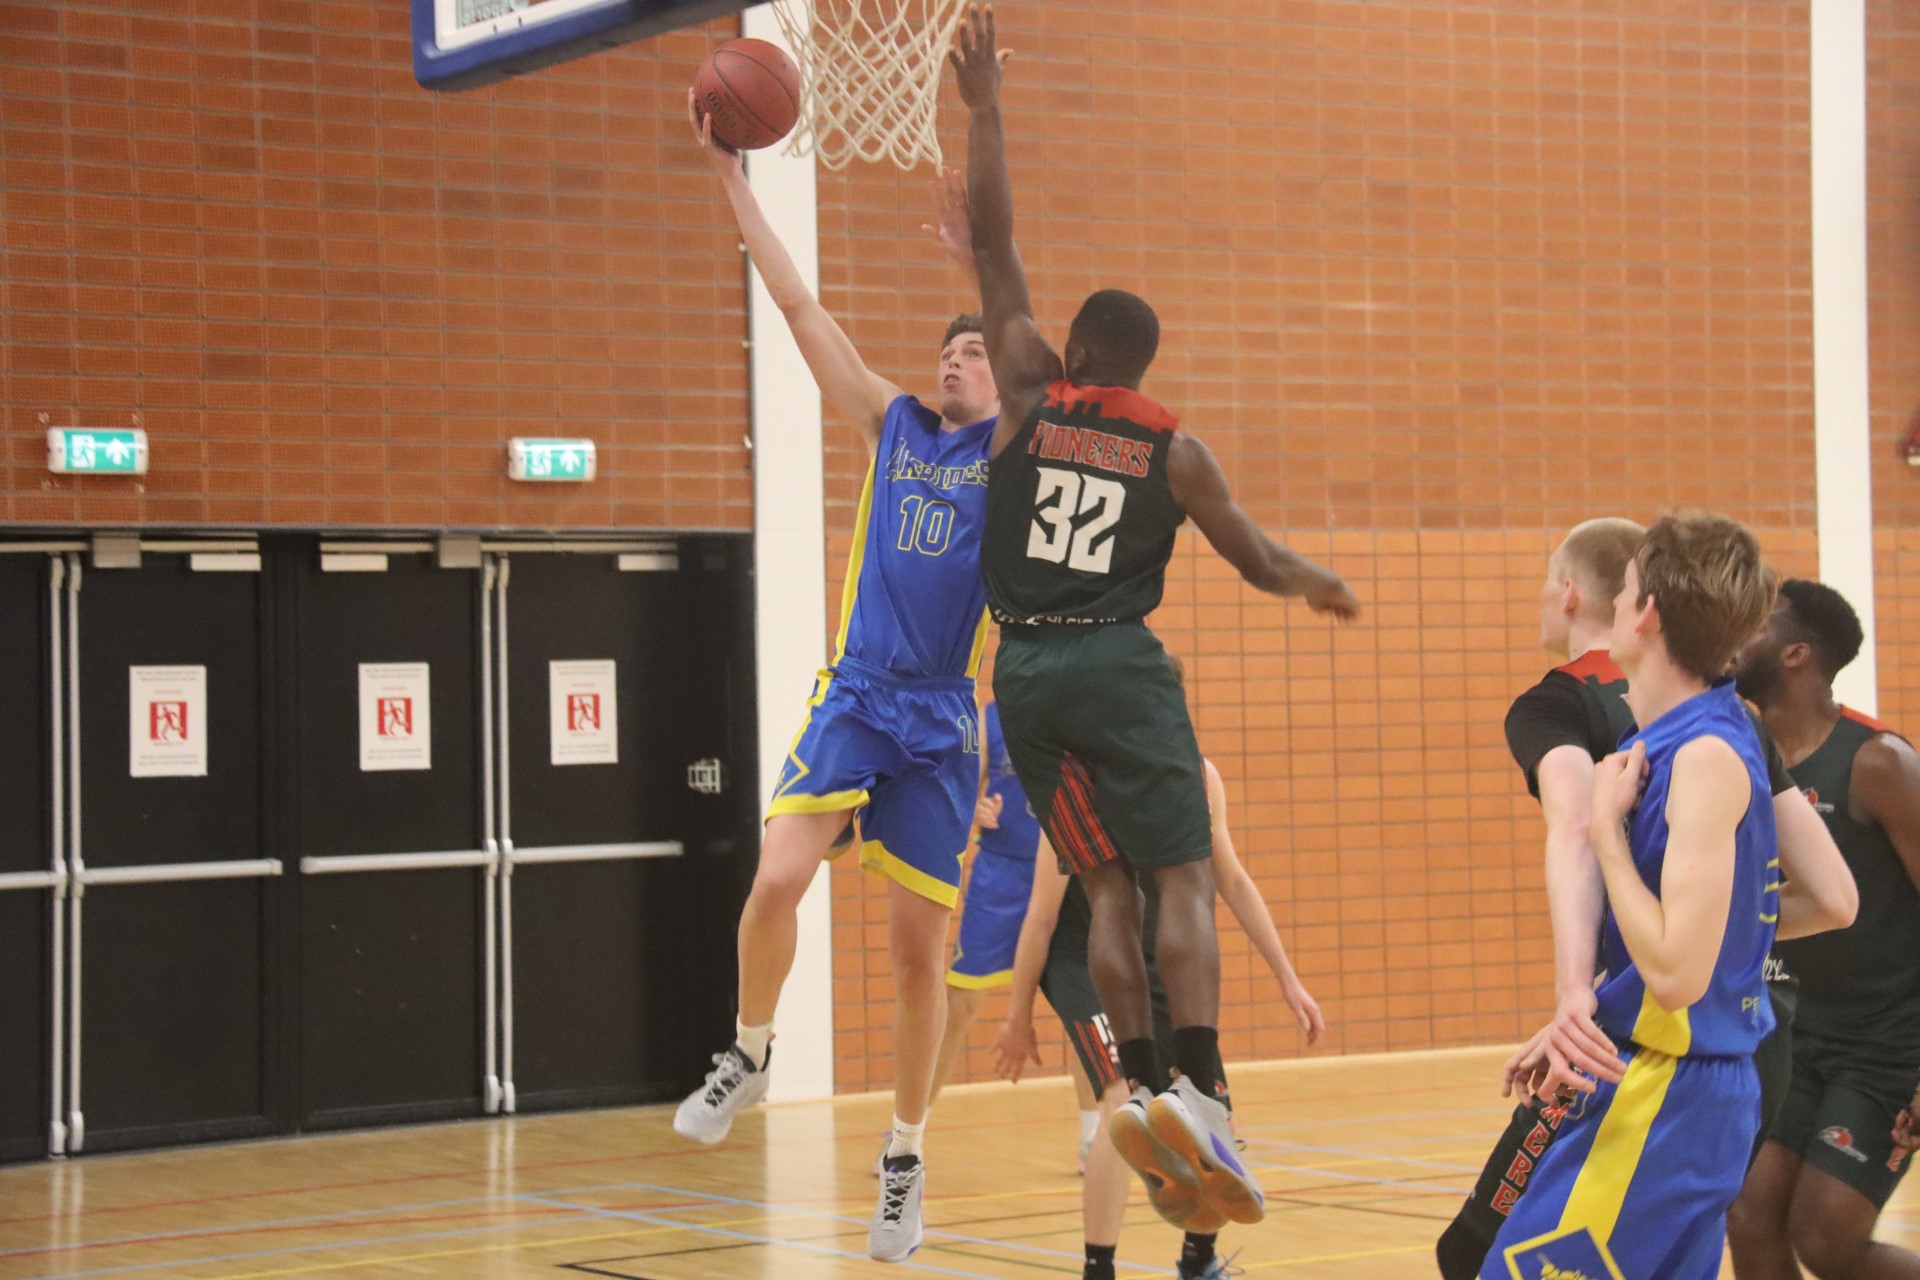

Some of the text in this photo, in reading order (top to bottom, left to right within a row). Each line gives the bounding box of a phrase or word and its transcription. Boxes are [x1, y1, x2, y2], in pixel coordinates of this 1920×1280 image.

[1028, 419, 1153, 478] PIONEERS
[897, 495, 955, 556] 10
[1027, 466, 1126, 574] 32
